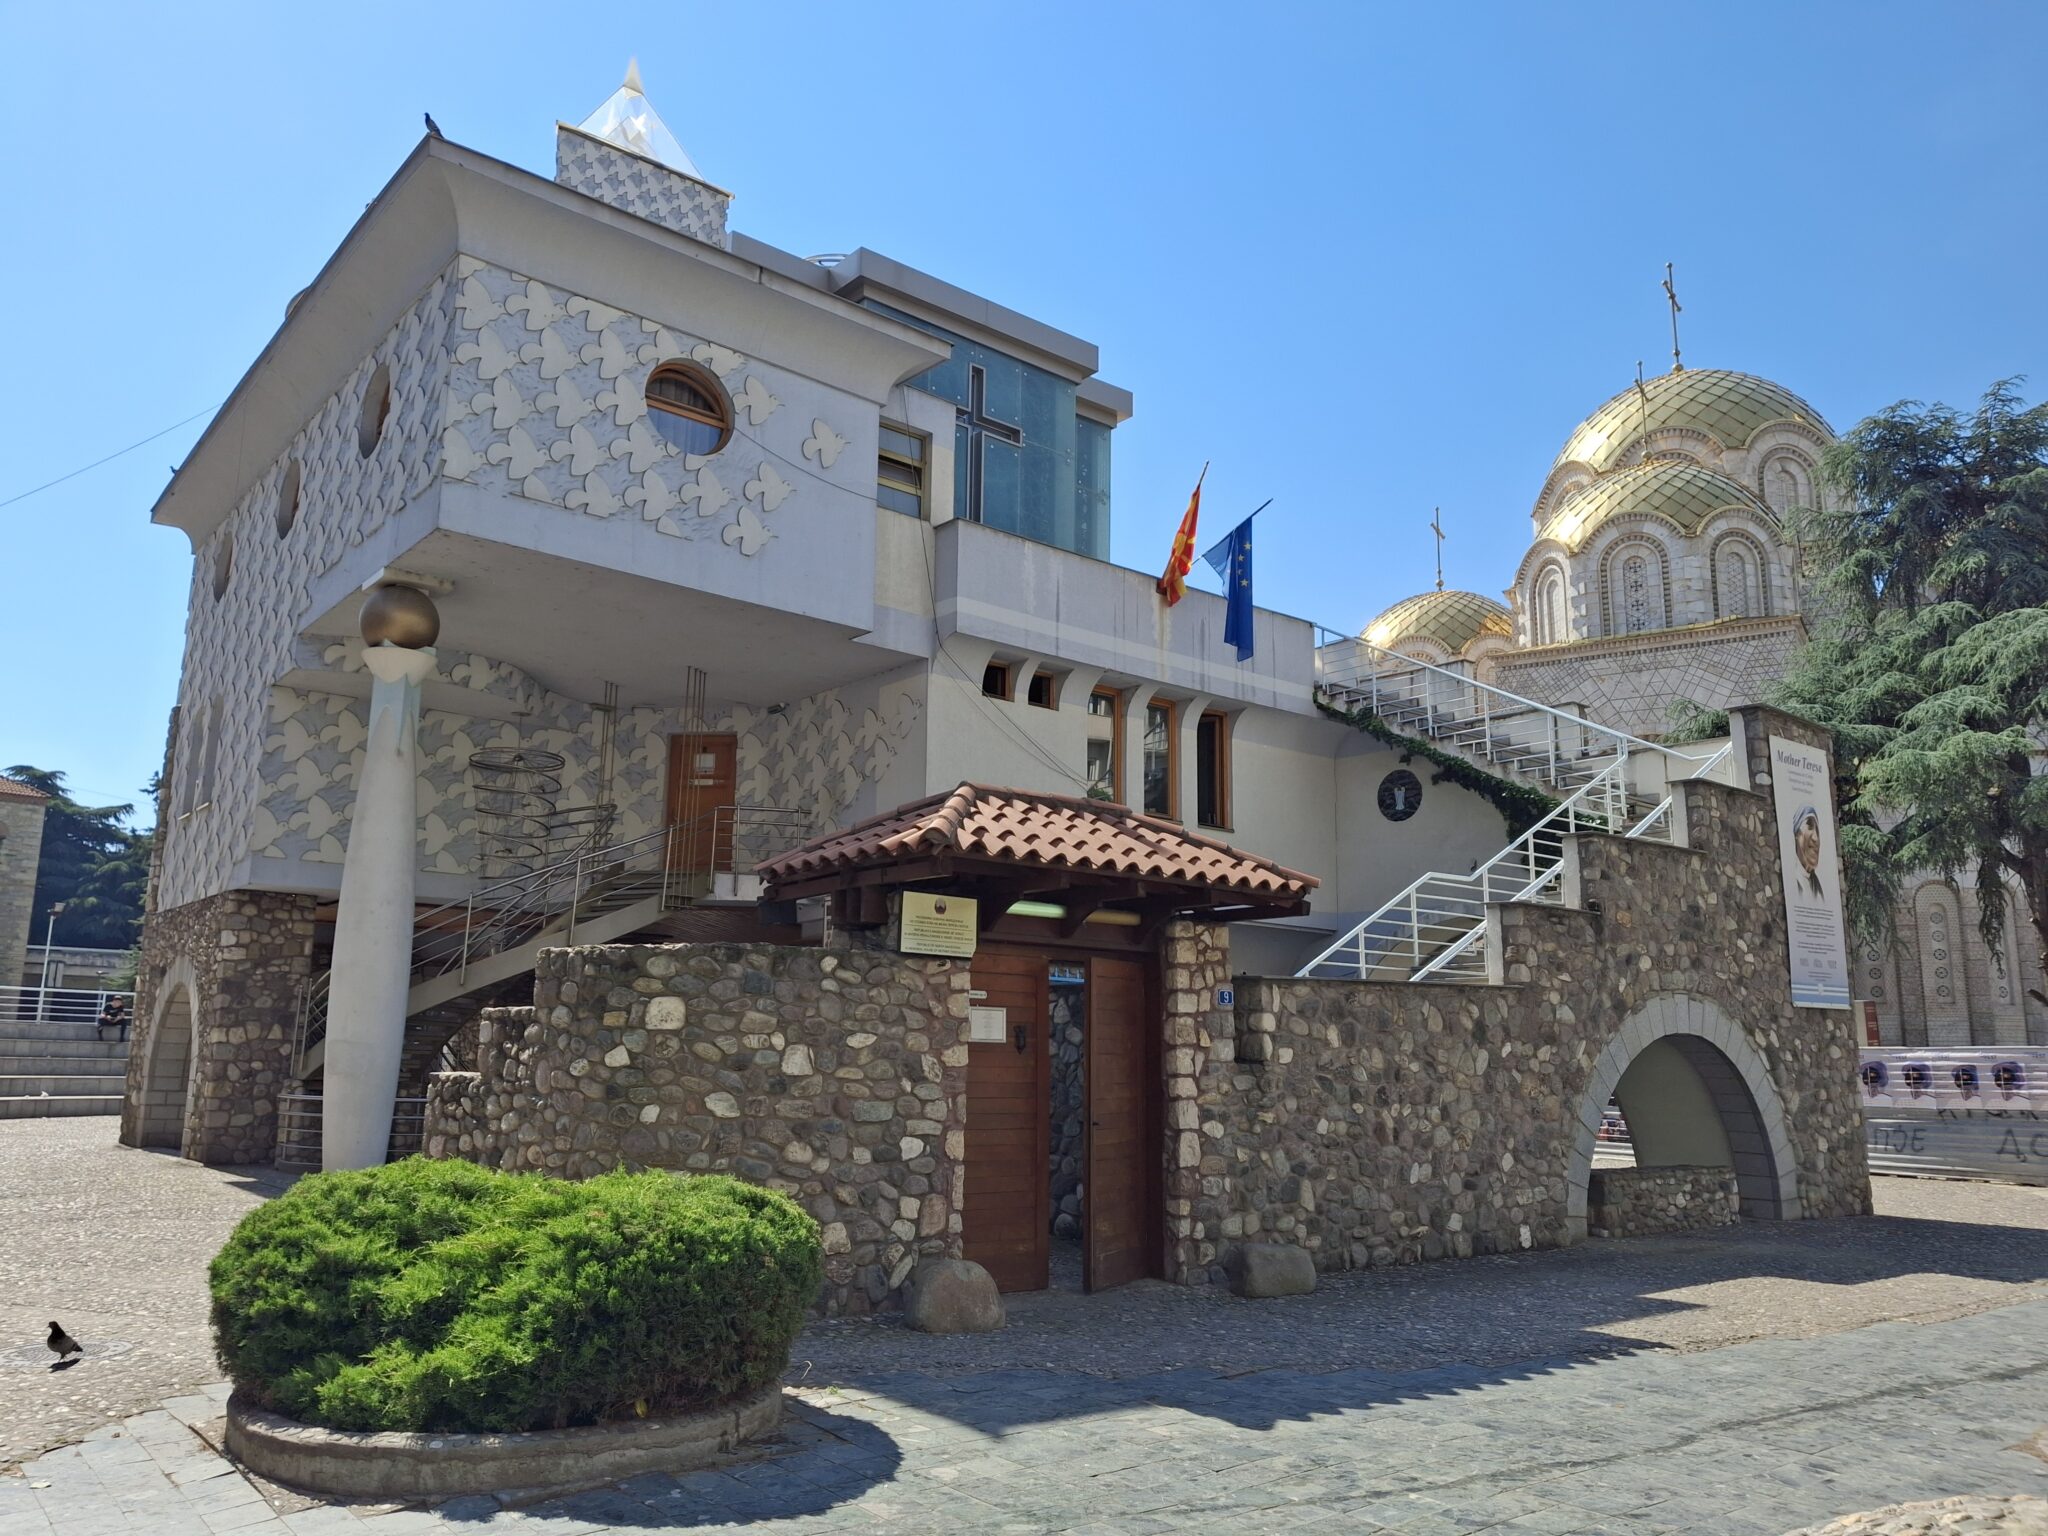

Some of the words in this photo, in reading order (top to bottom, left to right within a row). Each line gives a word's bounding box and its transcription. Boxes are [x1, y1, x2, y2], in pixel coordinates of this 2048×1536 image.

[1777, 749, 1801, 768] Mother
[1801, 756, 1823, 773] Teresa
[1223, 991, 1229, 1003] 9
